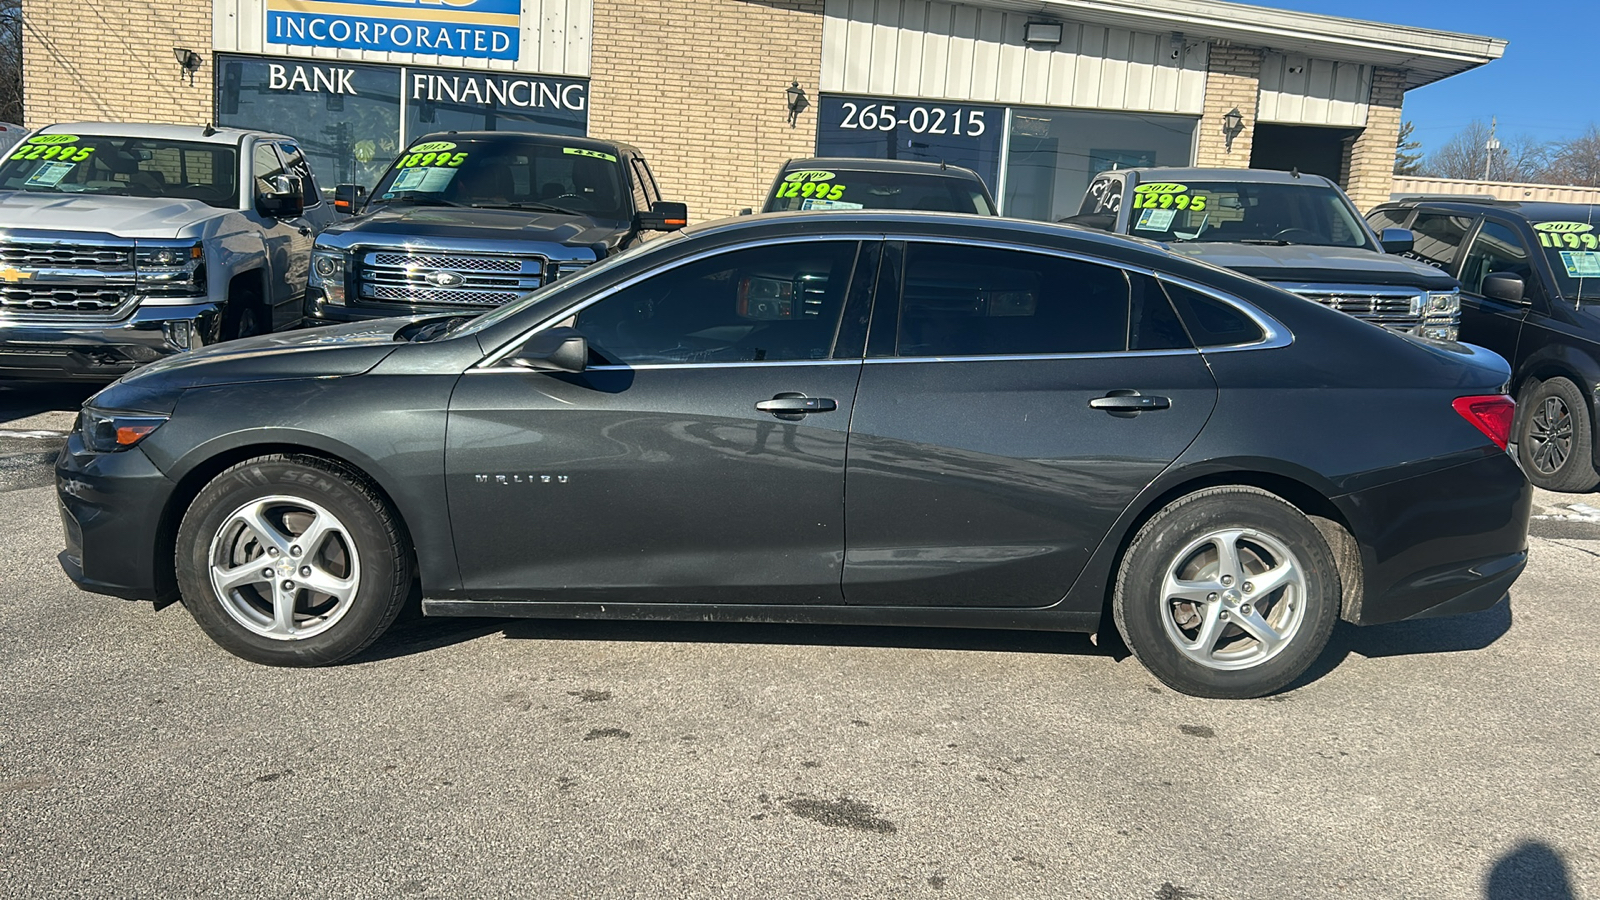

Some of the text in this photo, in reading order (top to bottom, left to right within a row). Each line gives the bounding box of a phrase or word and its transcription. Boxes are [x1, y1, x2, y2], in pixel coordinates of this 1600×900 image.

[276, 16, 510, 52] INCORPORATED
[268, 64, 585, 110] BANK FINANCING
[840, 102, 985, 137] 265-0215
[10, 145, 95, 161] 22995
[396, 152, 469, 169] 18995
[776, 182, 846, 200] 12995
[1133, 193, 1207, 211] 12995
[1545, 223, 1582, 231] 2017
[1538, 232, 1600, 249] 1199
[475, 474, 568, 485] MALIBU
